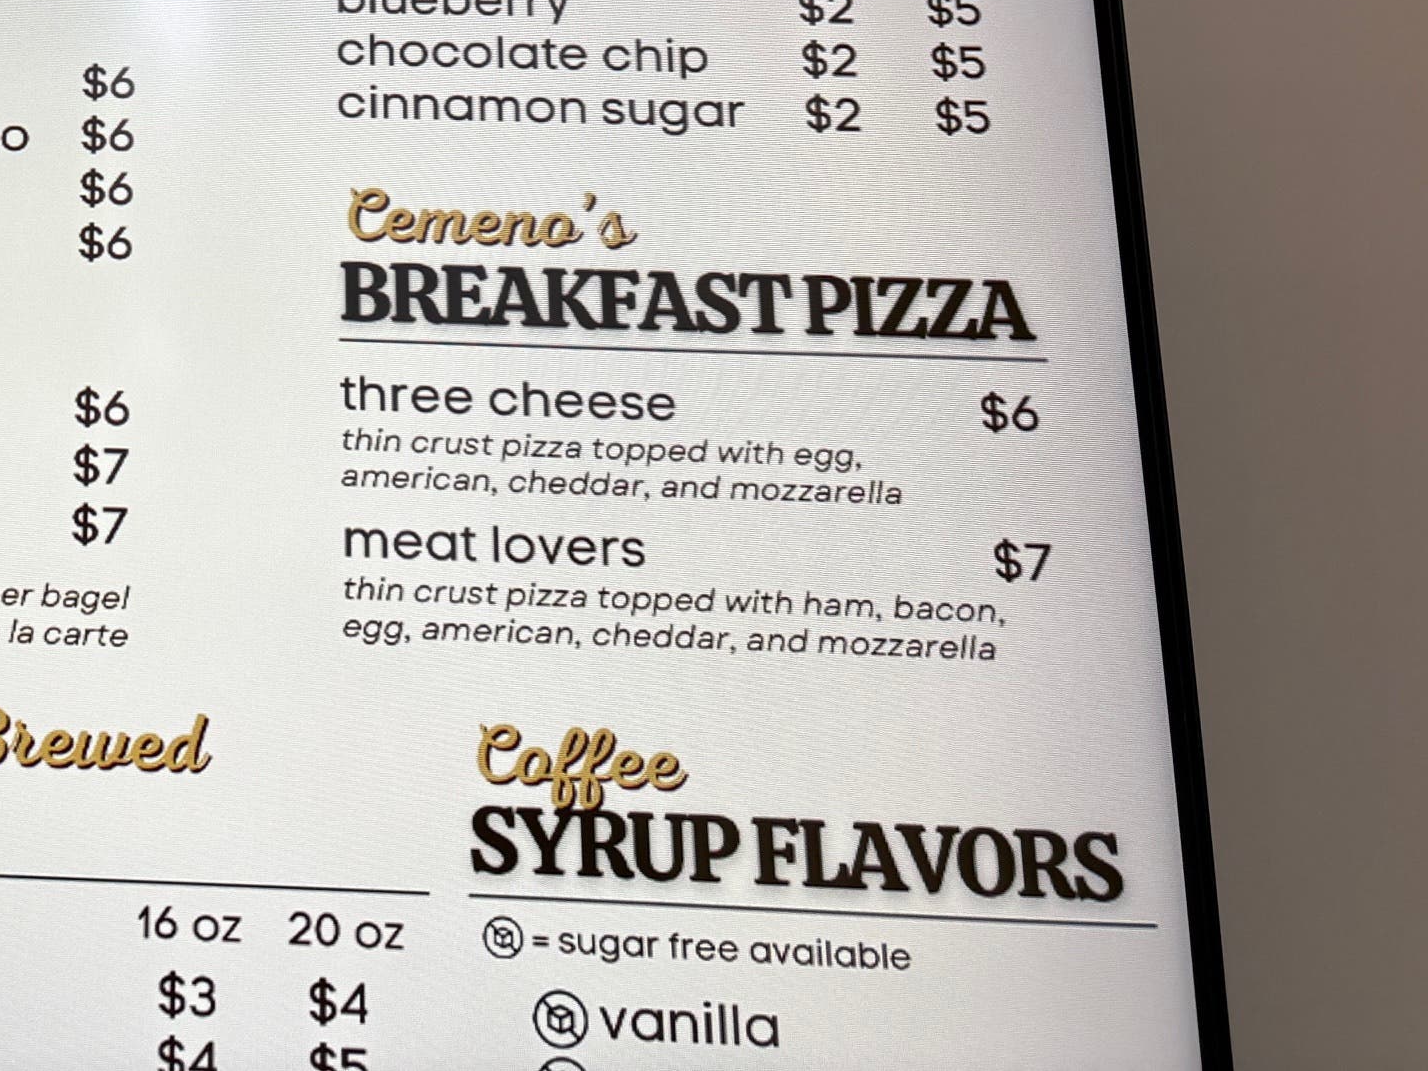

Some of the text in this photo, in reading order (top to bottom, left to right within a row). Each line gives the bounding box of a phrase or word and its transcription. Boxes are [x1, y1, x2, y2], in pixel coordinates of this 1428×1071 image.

[81, 62, 136, 102] $6
[337, 83, 992, 137] cinnamon sugar $2 $5
[77, 221, 133, 263] $6
[347, 186, 638, 250] Cemeno's
[339, 260, 1039, 344] BREAKFAST PIZZA
[74, 385, 131, 429] $6
[339, 374, 1041, 435] three cheese $6
[340, 465, 904, 505] american, cheddar, and mozzarella
[71, 501, 129, 547] $7
[343, 524, 1053, 584] meat lovers $7
[40, 581, 131, 616] bagel
[343, 575, 1006, 628] thin crust pizza topped with ham, bacon,
[7, 618, 35, 645] la
[42, 624, 129, 648] carte
[476, 723, 690, 810] Coffee
[469, 804, 1126, 904] SYRUP FLAVORS
[157, 969, 217, 1021] $3
[308, 976, 369, 1028] $4
[598, 999, 780, 1049] vanilla
